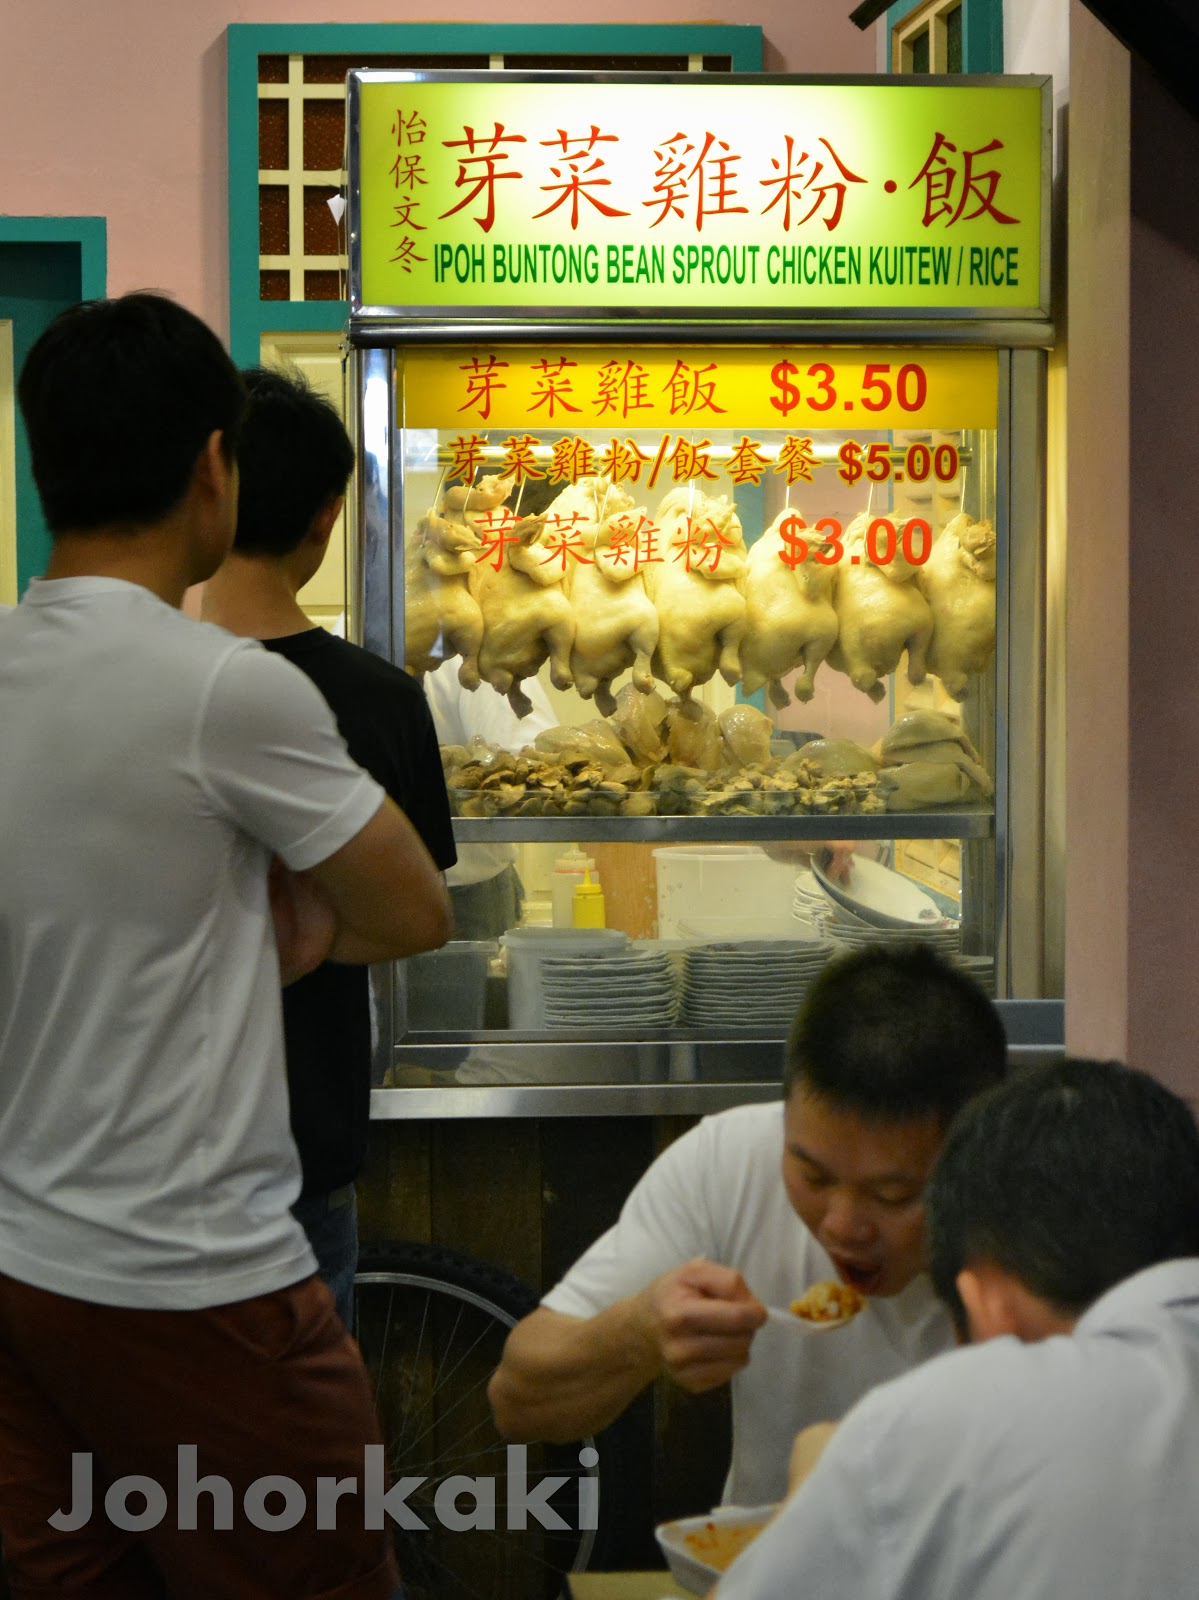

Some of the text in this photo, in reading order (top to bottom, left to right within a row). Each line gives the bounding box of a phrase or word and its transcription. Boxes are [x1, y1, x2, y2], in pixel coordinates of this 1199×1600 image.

[389, 109, 429, 273] 怡保文冬
[434, 244, 1019, 286] IPOH BUNTONG BEAN SPROUT CHICKEN KUITEW / RICE
[457, 355, 928, 420] 芽菜雞飯 $3.50
[837, 440, 959, 488] $5.00
[474, 509, 933, 573] 芽菜雞粉 $3.00
